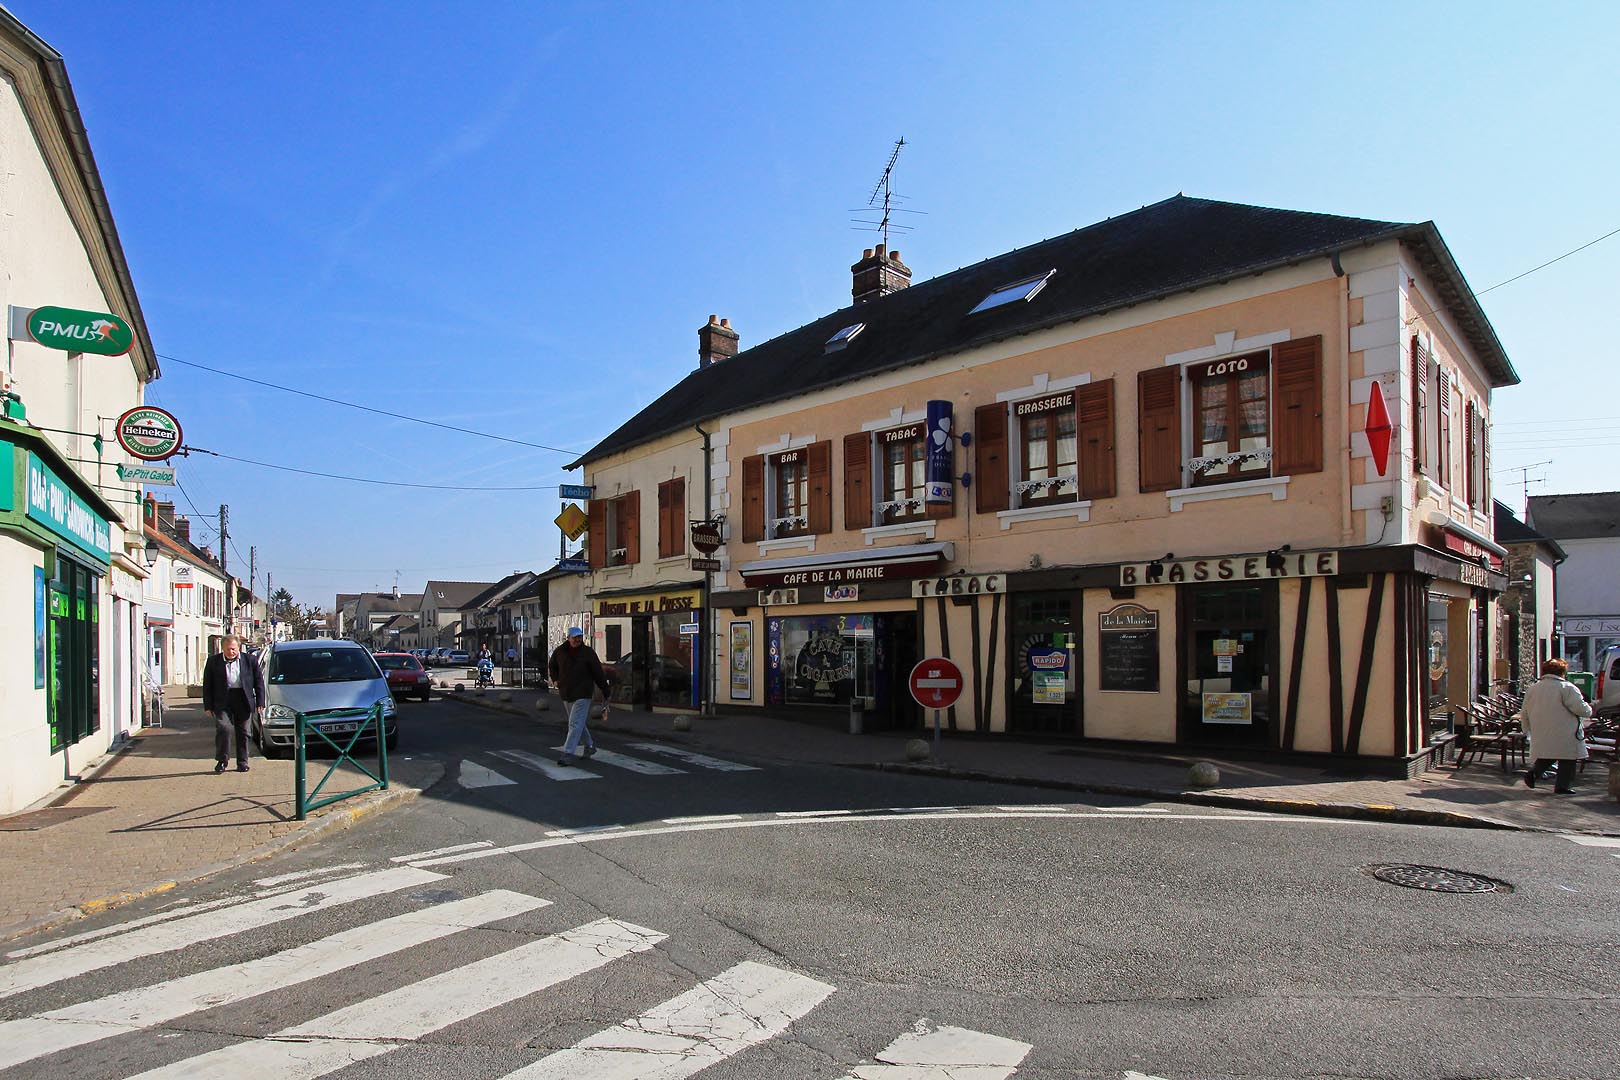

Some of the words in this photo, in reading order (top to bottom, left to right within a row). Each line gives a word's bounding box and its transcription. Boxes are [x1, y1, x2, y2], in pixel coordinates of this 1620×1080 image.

[38, 319, 89, 340] PMU
[1207, 358, 1249, 377] LOTO
[1018, 394, 1073, 416] BRASSERIE
[125, 426, 174, 439] Heineken
[885, 427, 917, 442] TABAC
[781, 452, 798, 463] BAR
[133, 468, 150, 479] P'tit
[149, 470, 174, 483] Galop
[32, 467, 47, 513] BAR
[50, 482, 64, 525] PMU
[693, 533, 720, 545] BRASSERIE
[783, 573, 807, 584] CAFE
[812, 572, 824, 582] DE
[828, 570, 841, 580] LA
[846, 567, 884, 580] MAIRIE
[1123, 553, 1333, 585] BRASSERIE
[760, 589, 795, 605] BAR
[826, 587, 856, 599] LOTO
[631, 601, 641, 614] DE
[660, 596, 694, 612] PRESSE
[1104, 616, 1115, 625] de
[1116, 615, 1124, 625] la
[1126, 615, 1152, 625] Mairie
[1574, 621, 1592, 632] Les
[809, 639, 842, 655] CAVE
[801, 664, 851, 683] CIGARES
